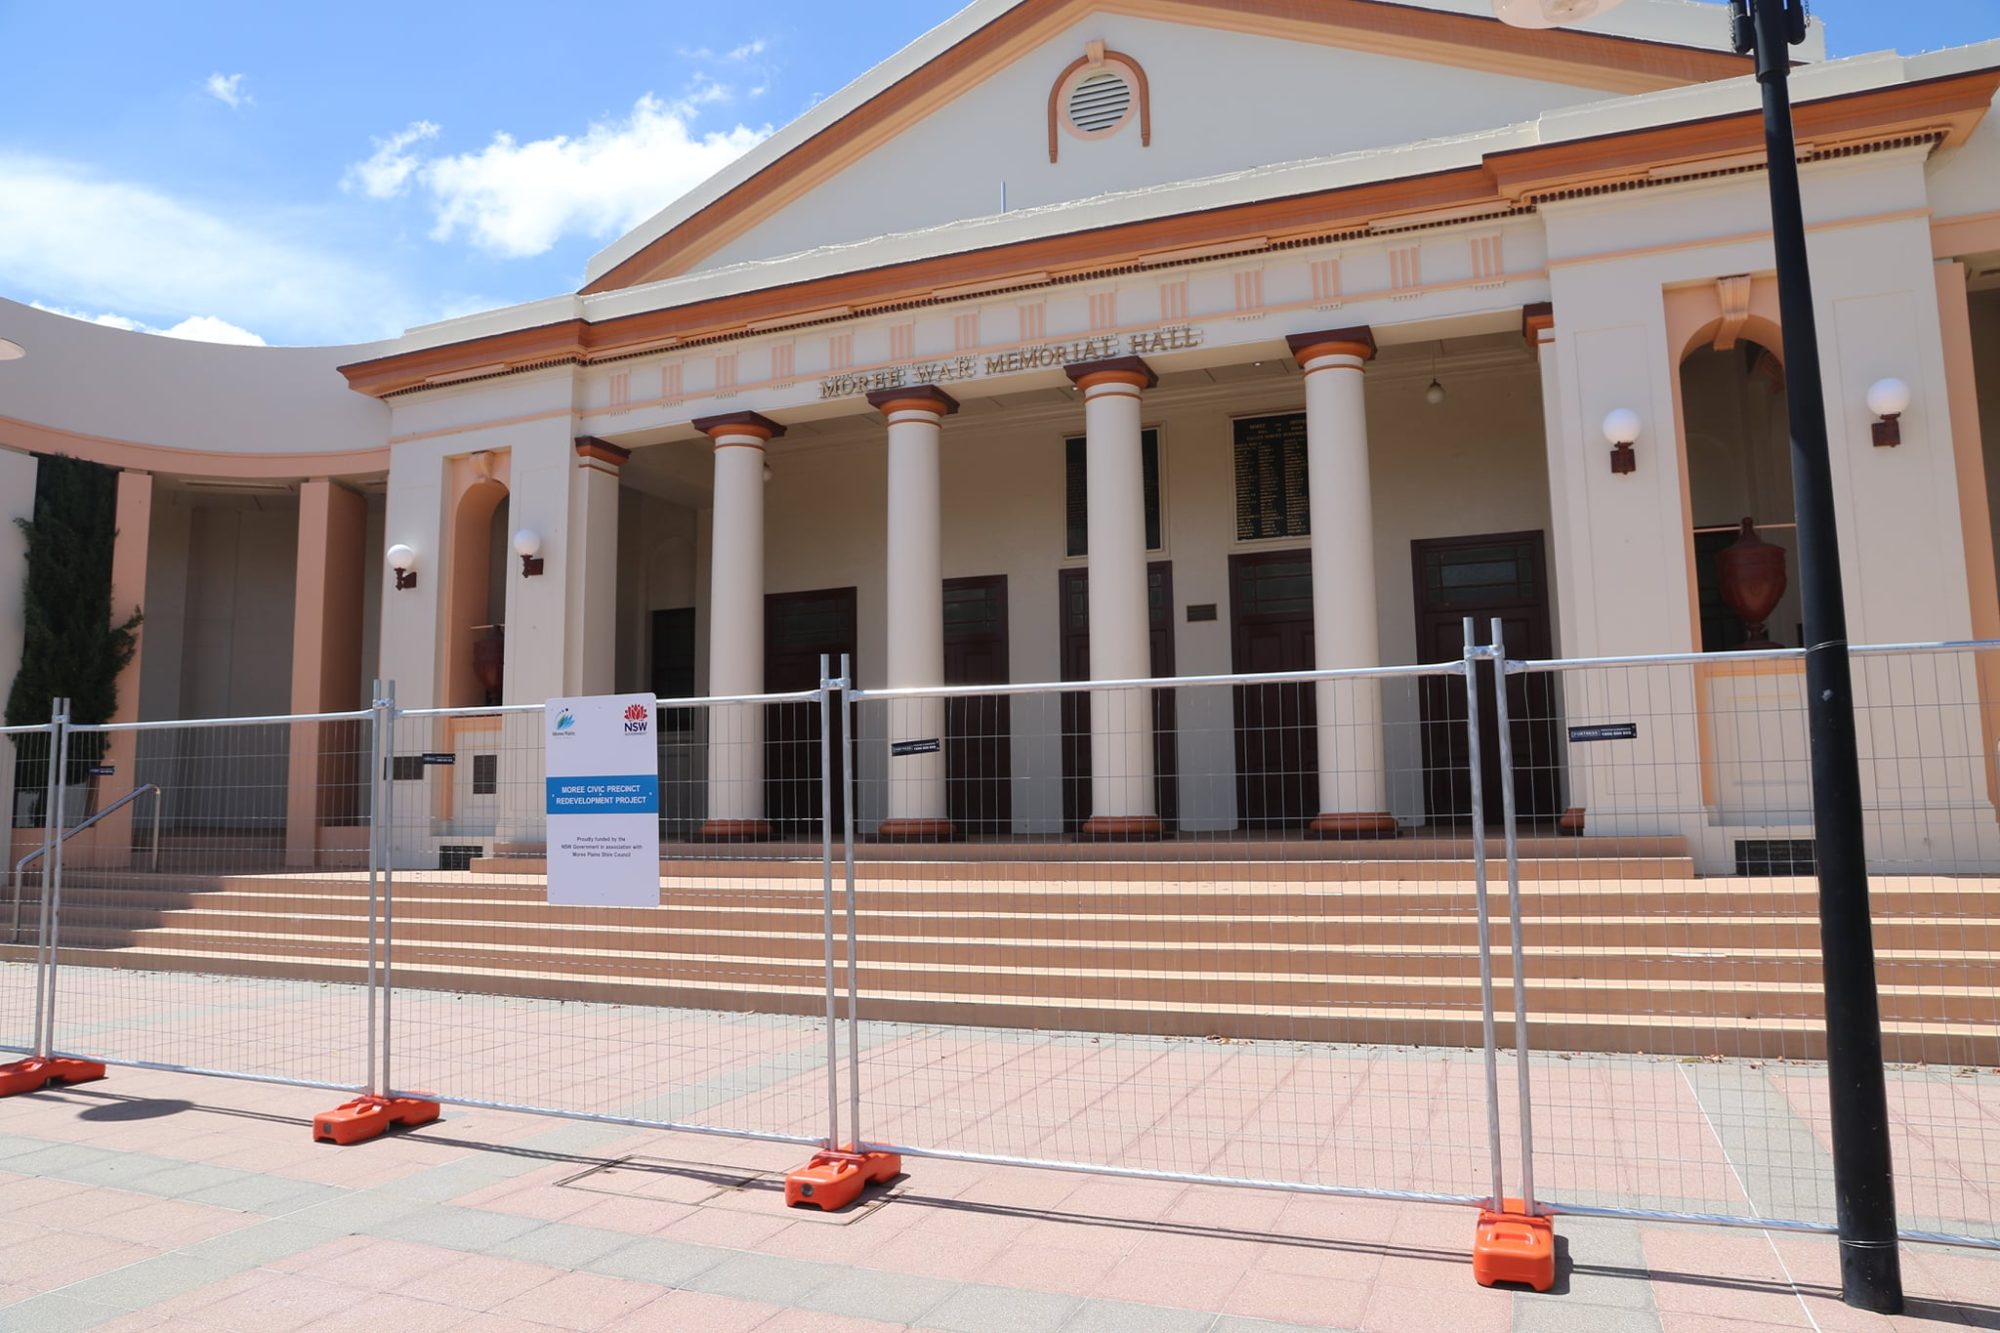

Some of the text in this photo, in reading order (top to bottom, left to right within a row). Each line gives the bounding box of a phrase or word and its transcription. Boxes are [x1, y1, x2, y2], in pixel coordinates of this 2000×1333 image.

[820, 328, 1200, 399] MOREE WAR MEMORIAL HALL
[624, 722, 648, 732] NSW
[561, 784, 641, 794] MOREE CIVIC PRECINCT
[556, 796, 647, 805] REDEVELOPMENT PROJECT
